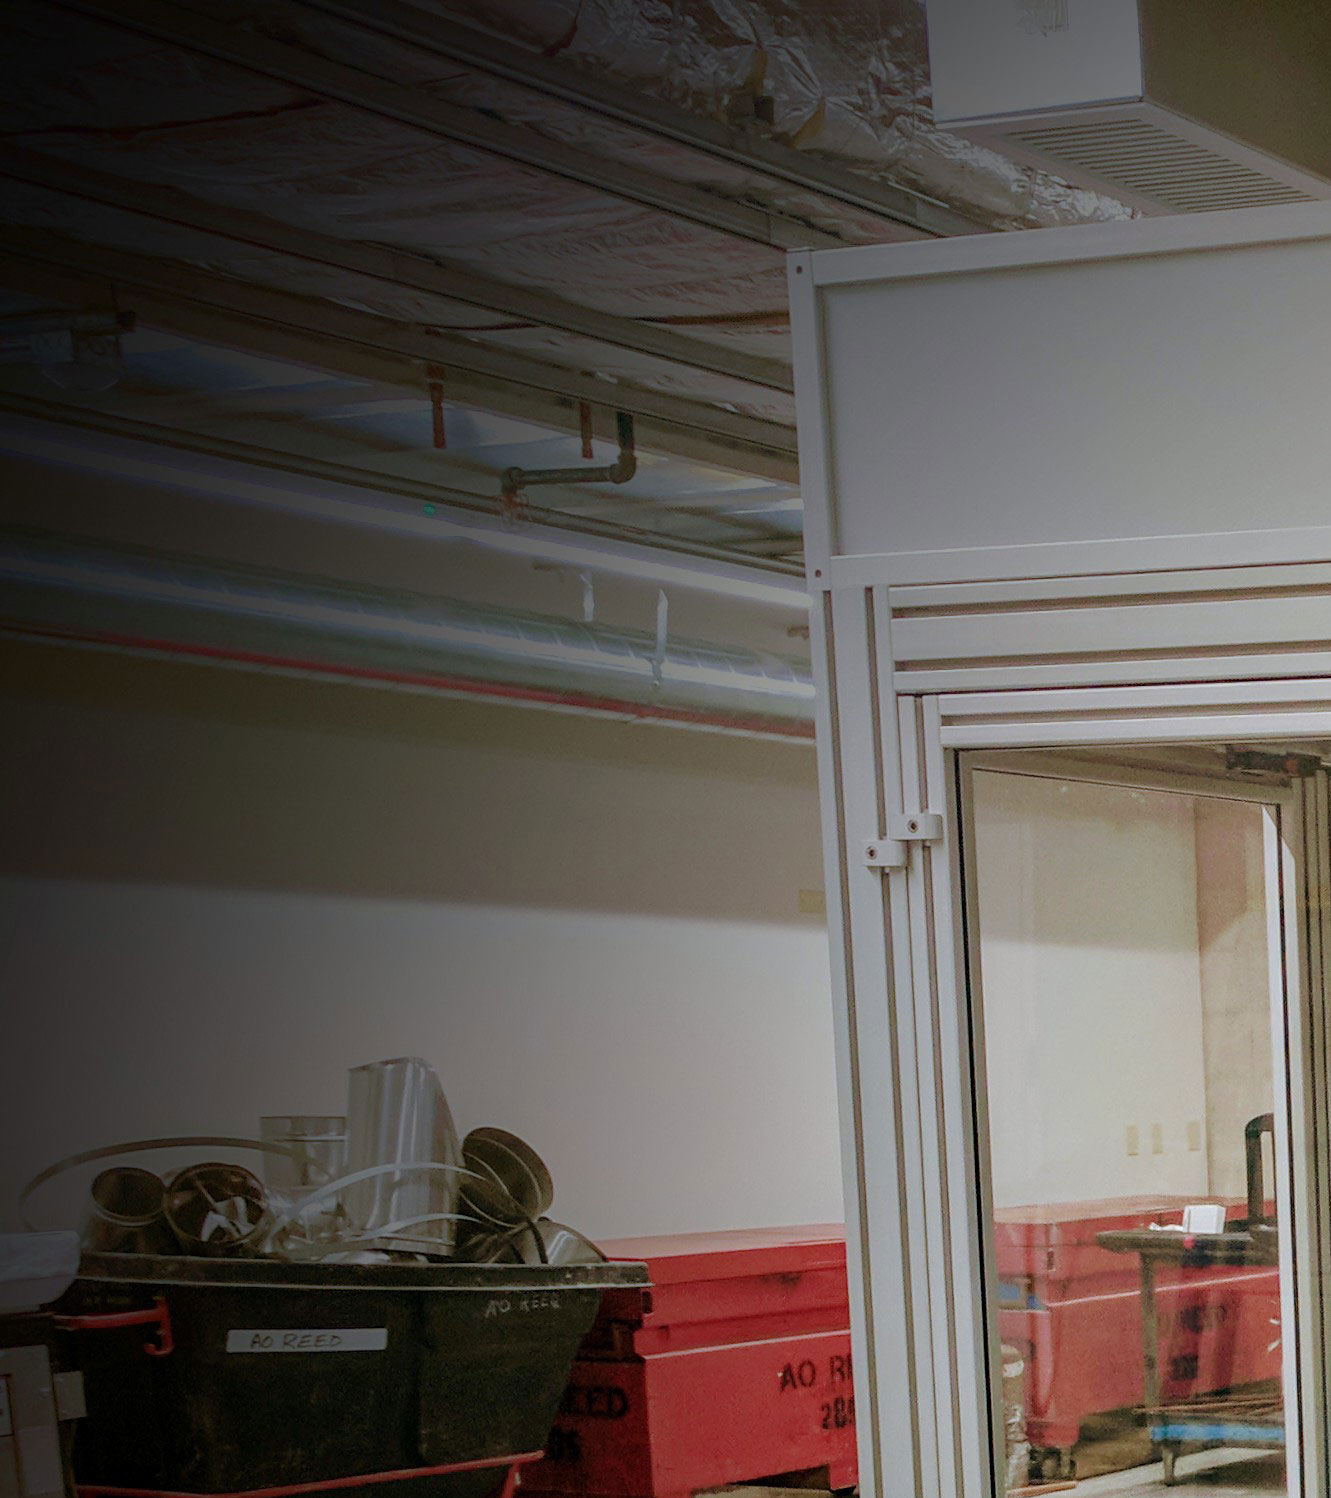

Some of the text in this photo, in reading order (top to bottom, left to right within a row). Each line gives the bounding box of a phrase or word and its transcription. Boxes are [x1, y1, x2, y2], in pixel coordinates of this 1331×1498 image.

[251, 1333, 343, 1350] AO REED
[780, 1359, 816, 1392] AO
